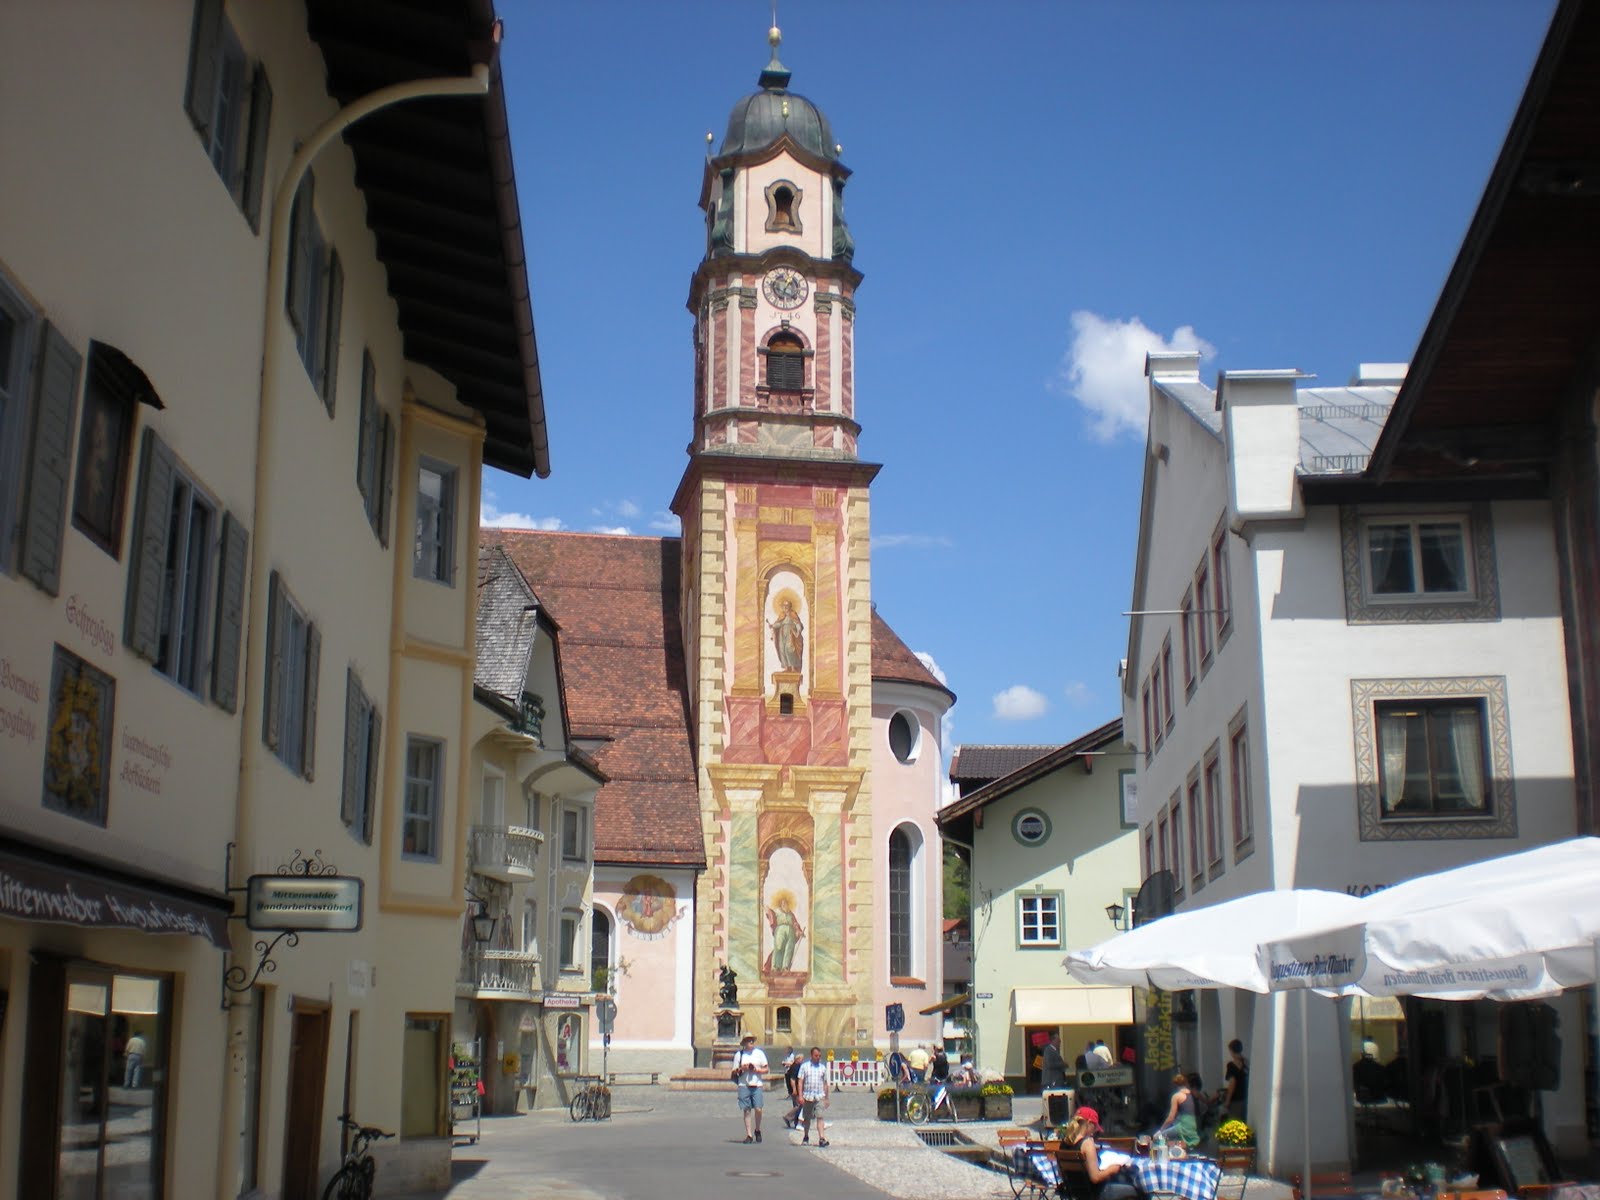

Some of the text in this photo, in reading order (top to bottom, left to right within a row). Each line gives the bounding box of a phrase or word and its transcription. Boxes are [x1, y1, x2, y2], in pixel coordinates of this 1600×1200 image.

[256, 901, 353, 911] Handarbeitsstüberl
[271, 891, 338, 899] Mittenwalder
[1159, 990, 1175, 1071] Wolfskin
[1144, 1025, 1160, 1071] Jack
